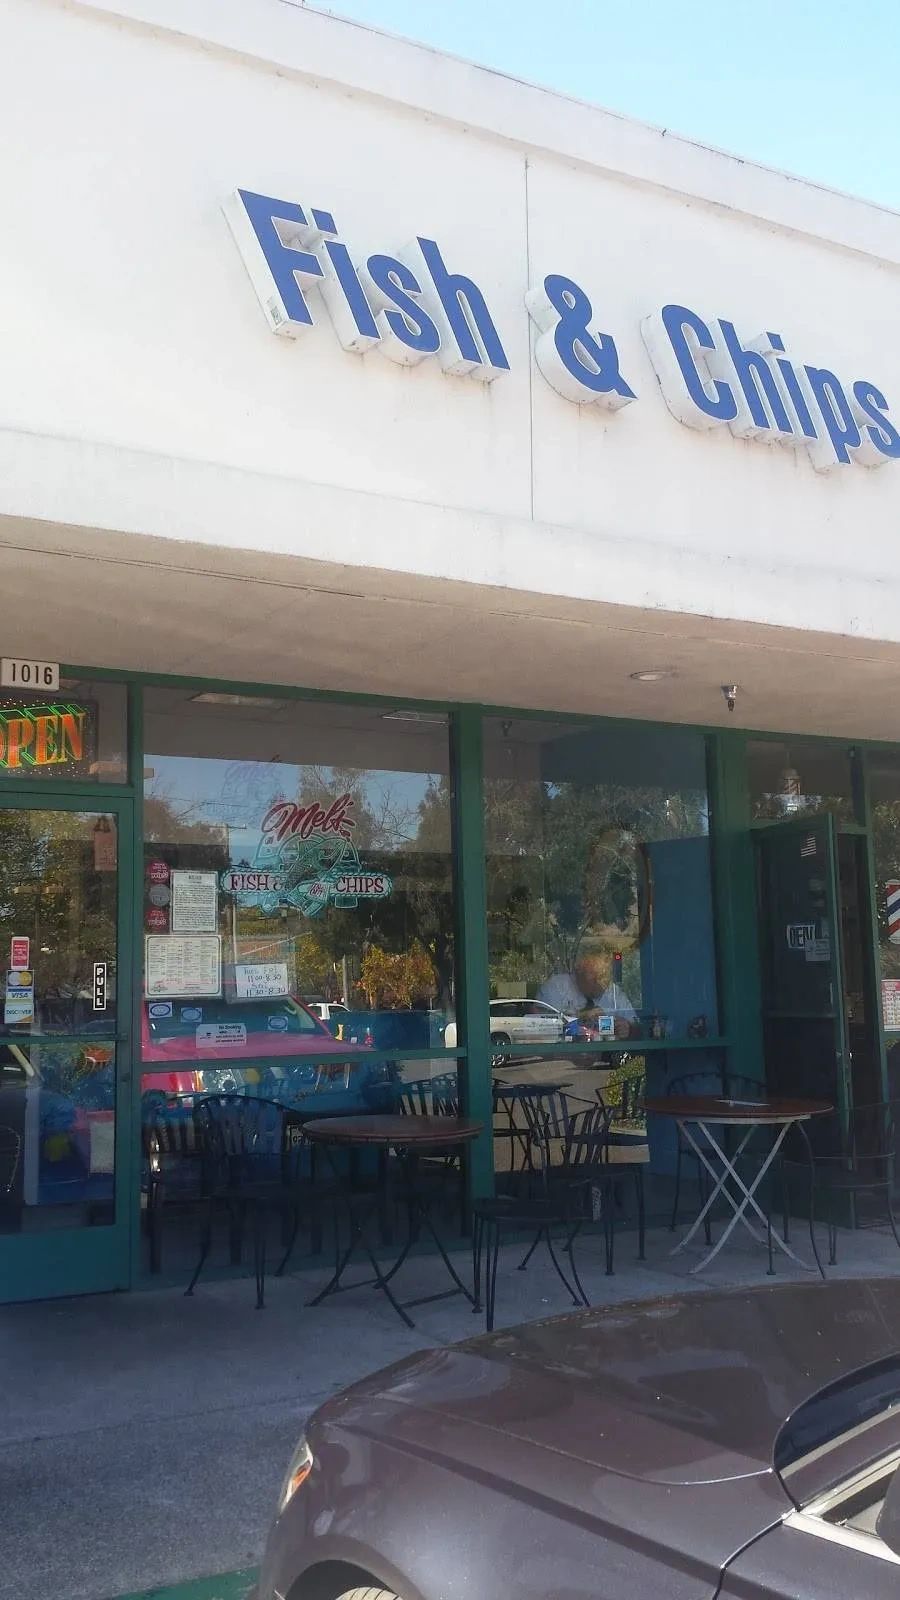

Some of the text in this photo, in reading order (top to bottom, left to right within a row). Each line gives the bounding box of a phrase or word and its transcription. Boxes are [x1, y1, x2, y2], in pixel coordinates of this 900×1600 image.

[237, 188, 900, 464] Fish & Chips
[11, 662, 54, 686] 1016
[0, 706, 86, 768] PEN
[230, 874, 269, 891] FISH
[336, 876, 385, 893] CHIPS
[95, 967, 104, 1006] PULL
